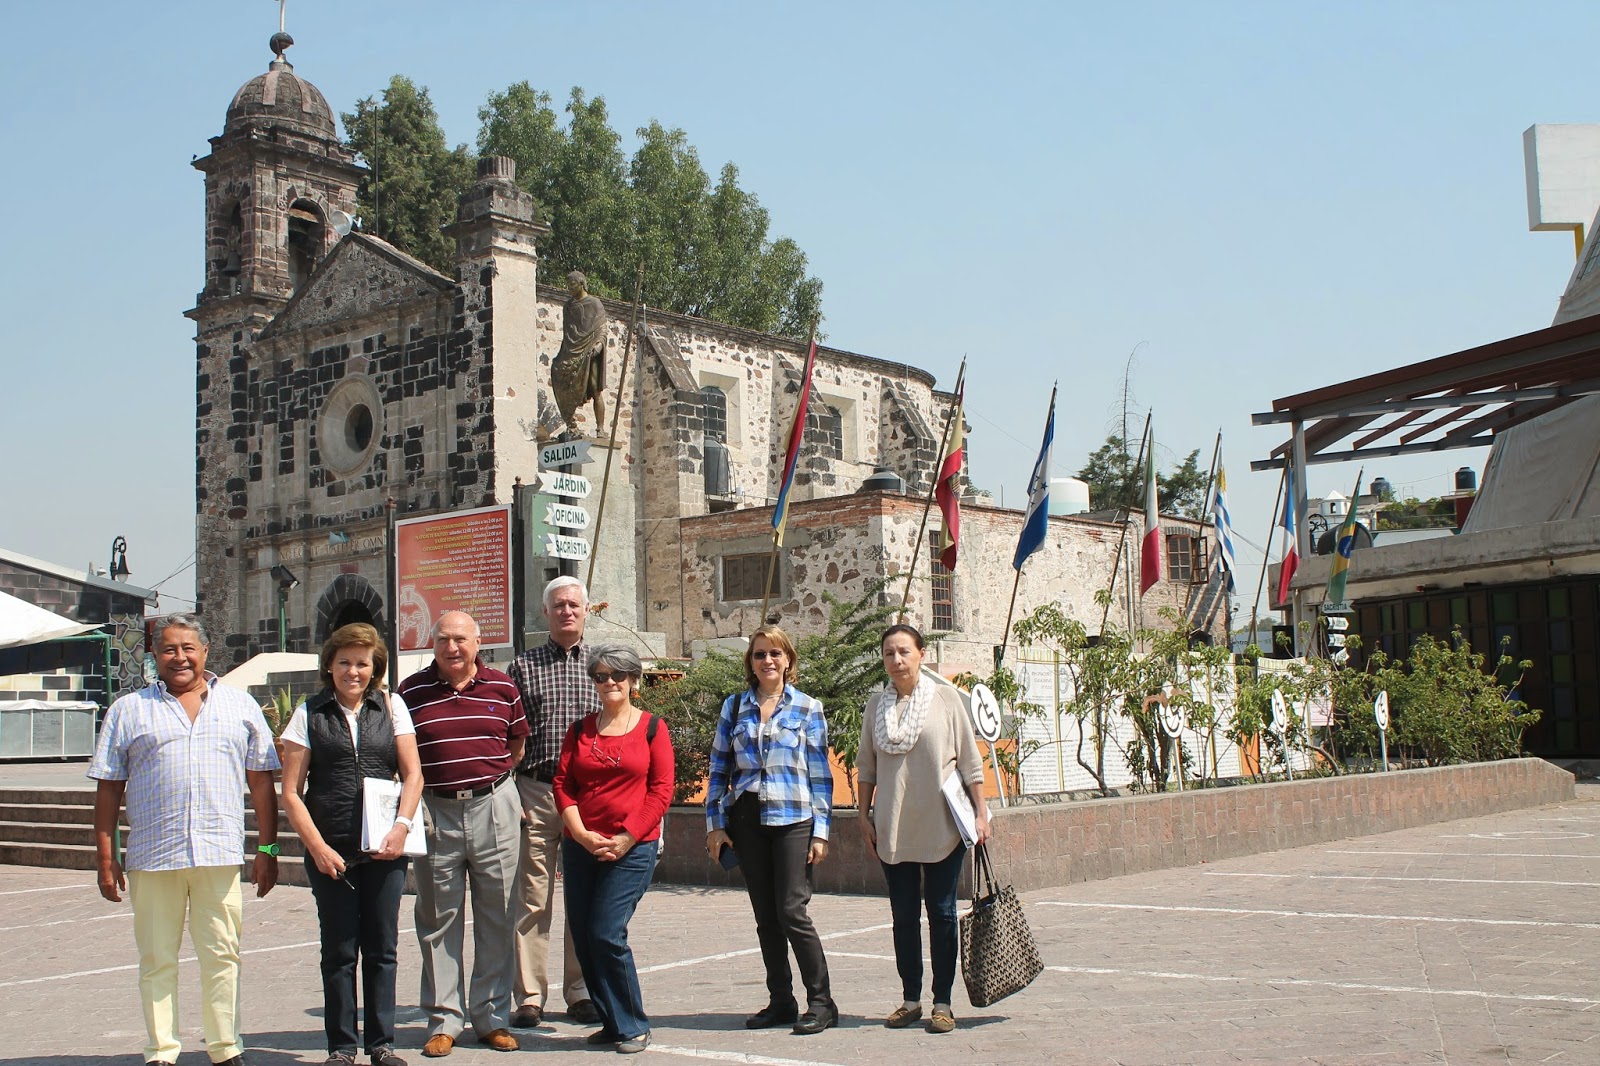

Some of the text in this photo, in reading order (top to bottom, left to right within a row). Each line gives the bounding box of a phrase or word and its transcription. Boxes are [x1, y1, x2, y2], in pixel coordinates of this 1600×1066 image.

[544, 445, 577, 463] SALIDA
[553, 477, 586, 494] JARDIN
[555, 508, 586, 526] OFICINA
[556, 540, 588, 556] SACRISTIA
